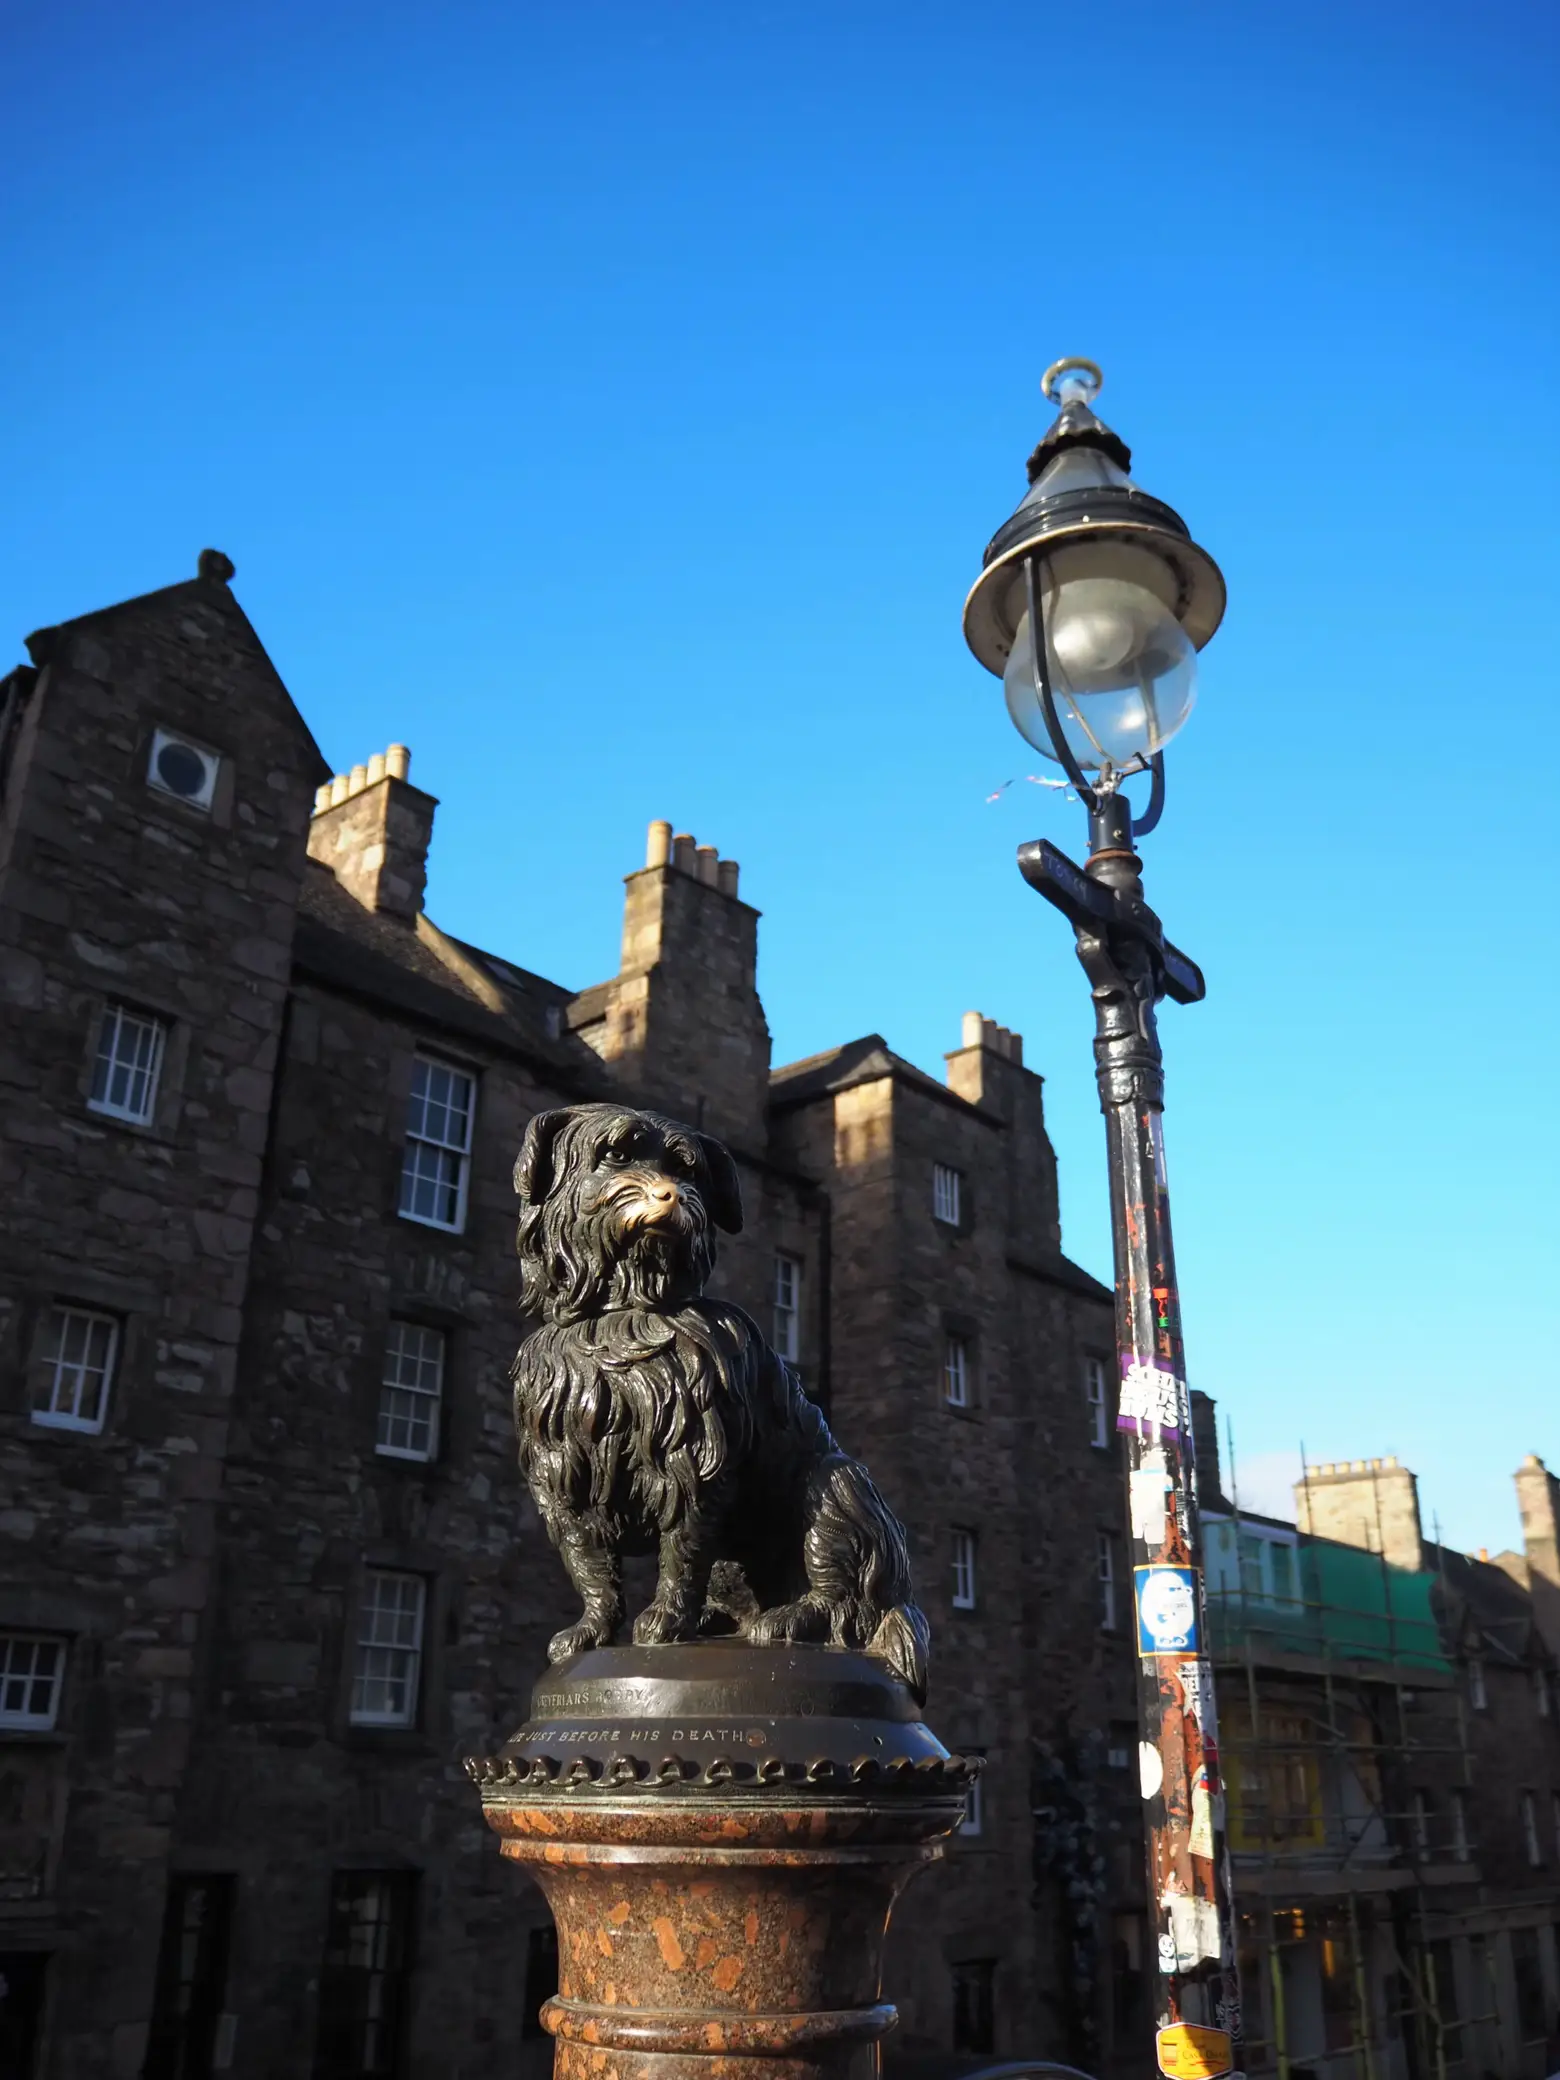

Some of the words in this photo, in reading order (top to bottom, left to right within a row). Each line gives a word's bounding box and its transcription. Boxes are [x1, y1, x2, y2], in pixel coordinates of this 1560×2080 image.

[526, 1730, 557, 1743] JUST
[558, 1730, 621, 1743] BEFORE
[630, 1730, 660, 1742] HIS
[672, 1729, 743, 1743] DEATH
